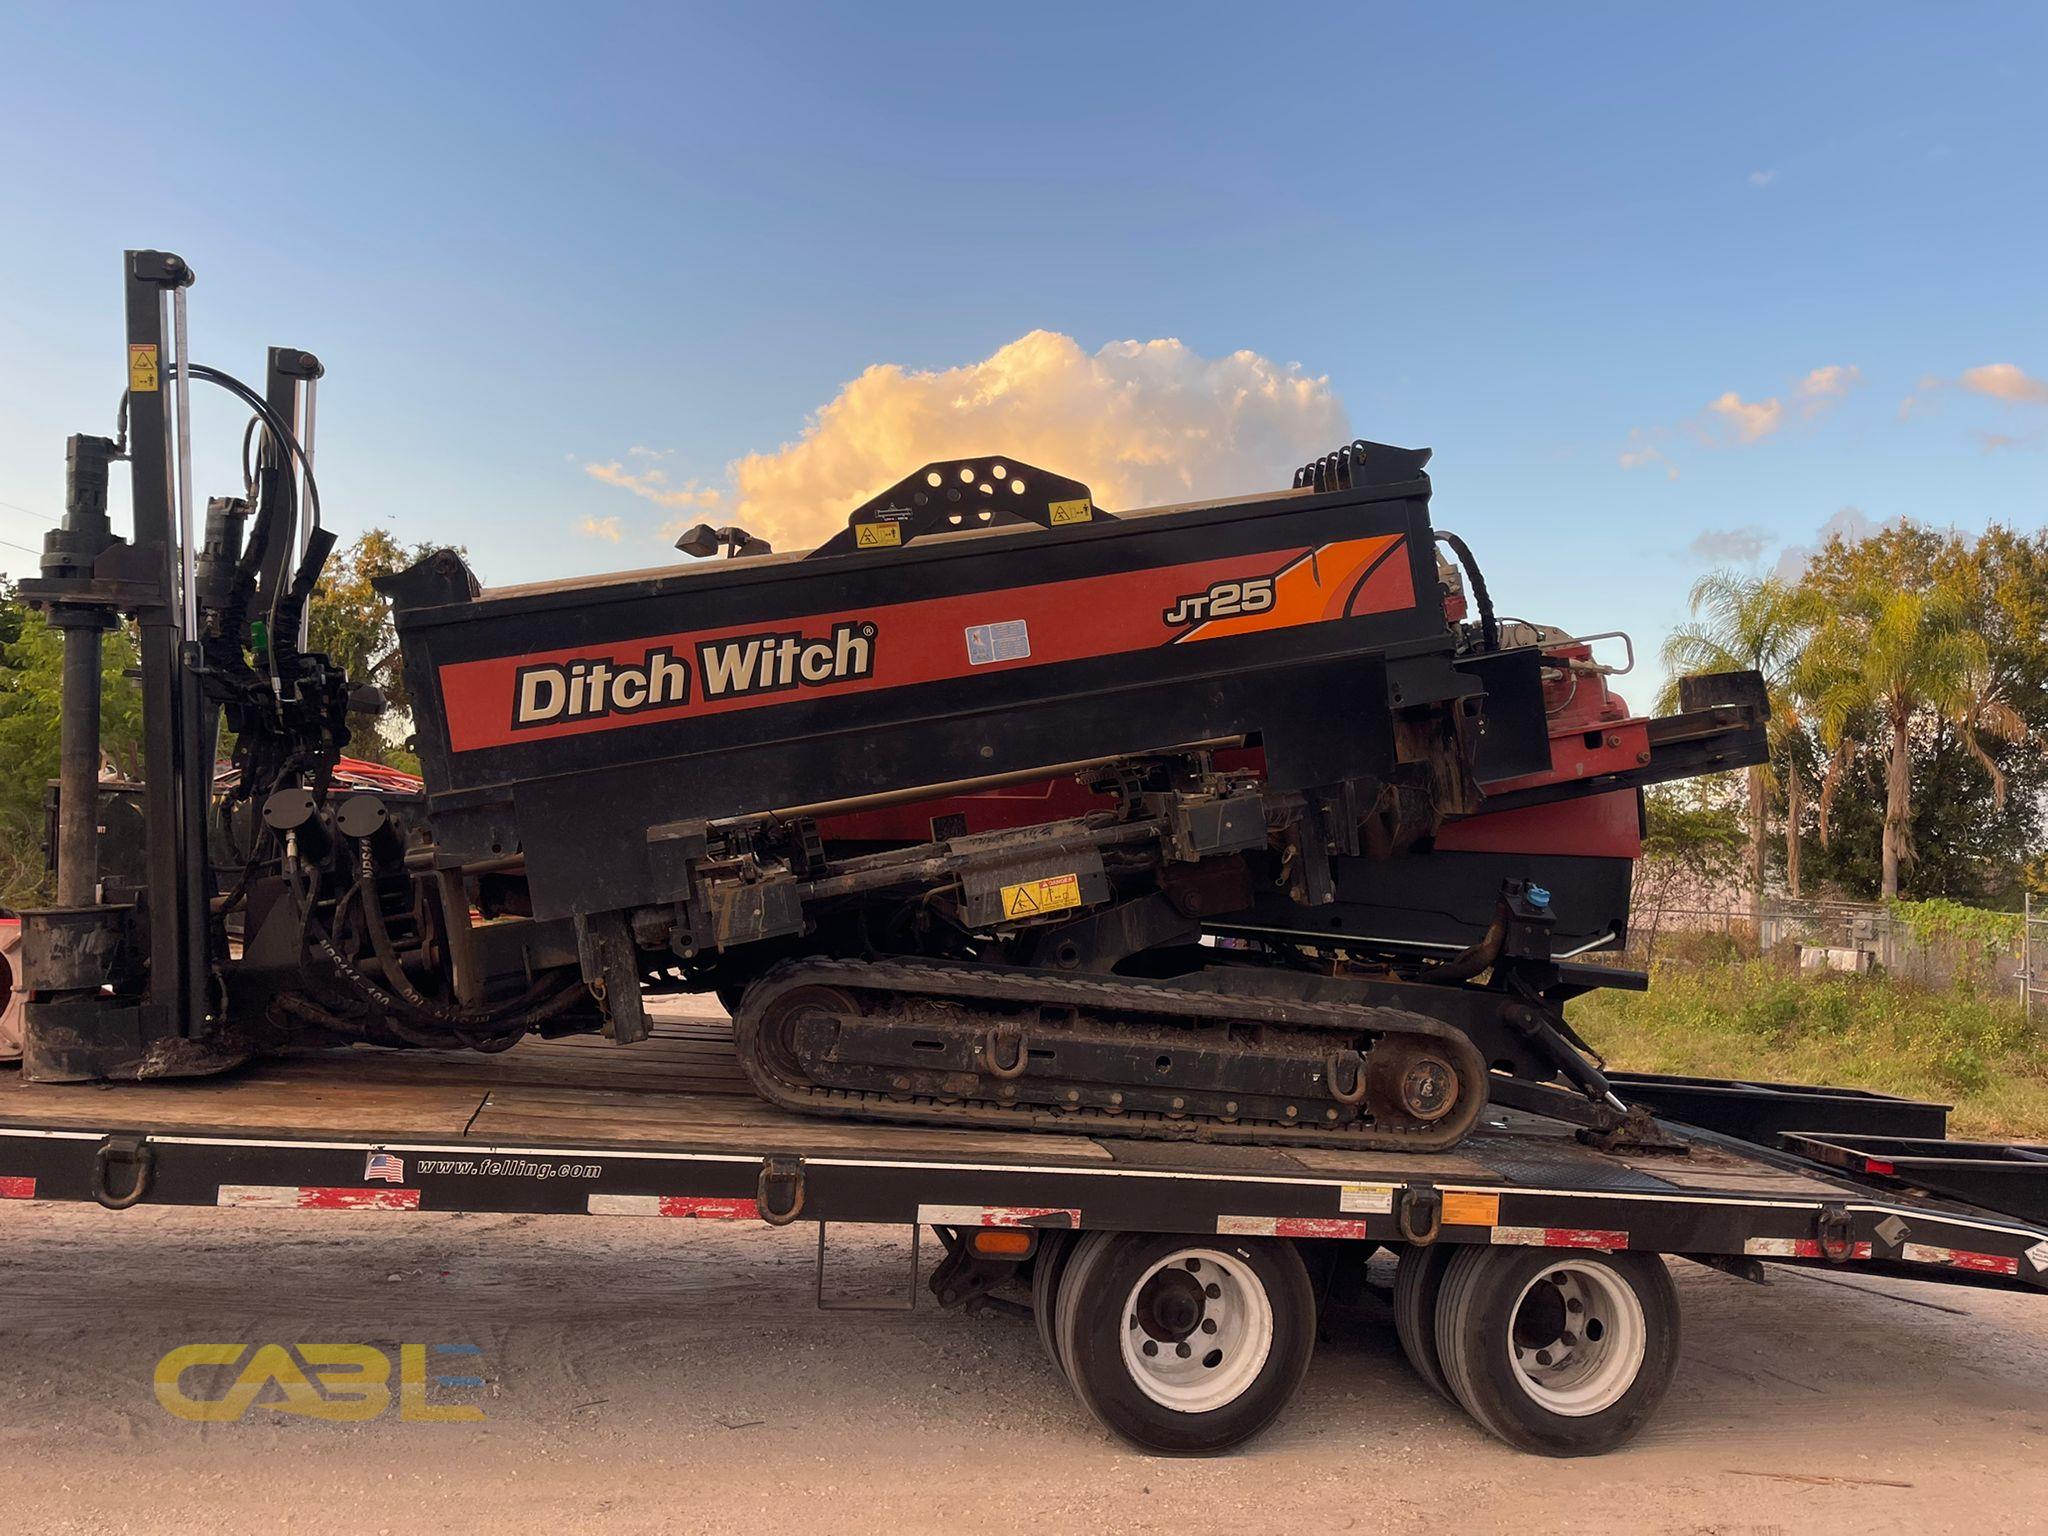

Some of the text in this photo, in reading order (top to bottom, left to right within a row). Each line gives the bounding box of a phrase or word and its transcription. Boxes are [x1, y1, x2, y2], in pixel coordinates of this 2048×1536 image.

[1167, 579, 1272, 623] JT25
[519, 654, 684, 723] Ditch
[417, 1158, 602, 1179] www.felling.com
